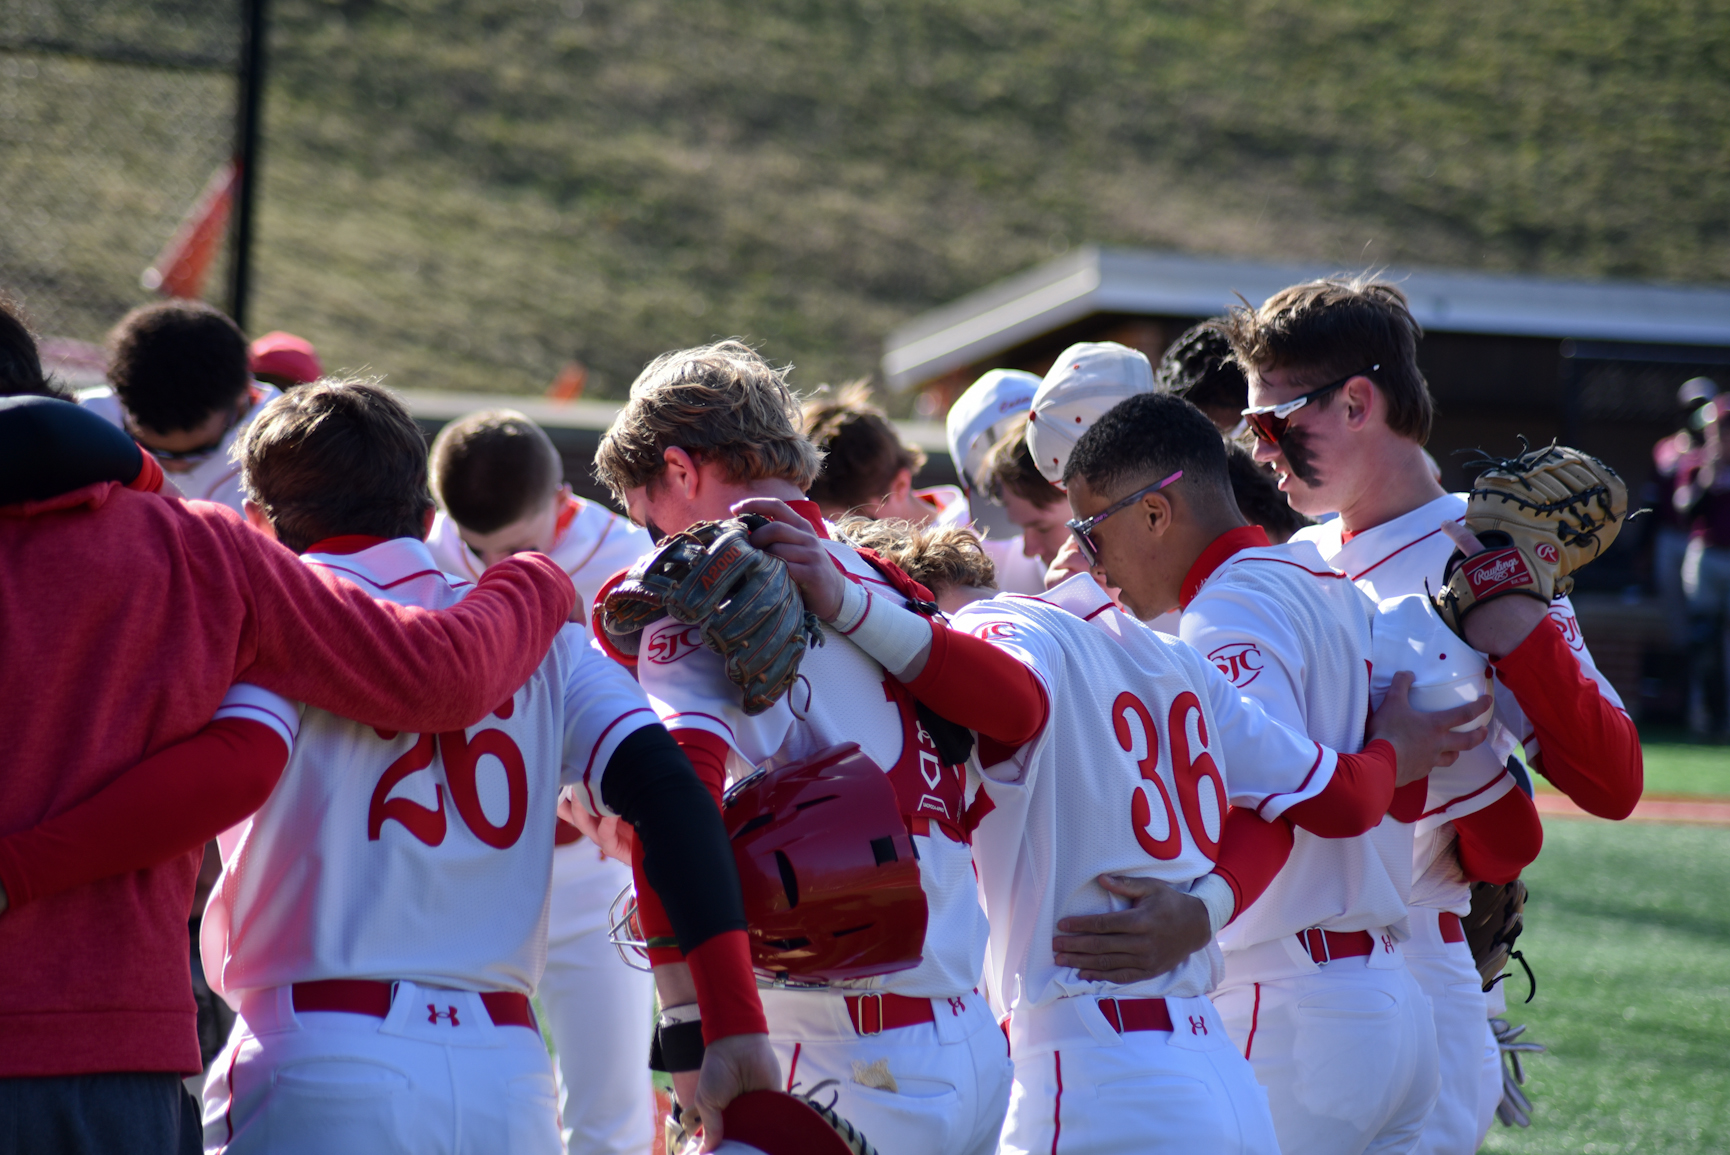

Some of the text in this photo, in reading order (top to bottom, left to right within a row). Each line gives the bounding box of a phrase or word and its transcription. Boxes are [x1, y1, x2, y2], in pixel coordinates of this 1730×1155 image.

[701, 545, 742, 591] A2000
[1473, 557, 1519, 586] Rawlings
[1537, 543, 1557, 562] R
[647, 626, 704, 662] SJC
[367, 695, 529, 850] 26
[1111, 690, 1229, 865] 36
